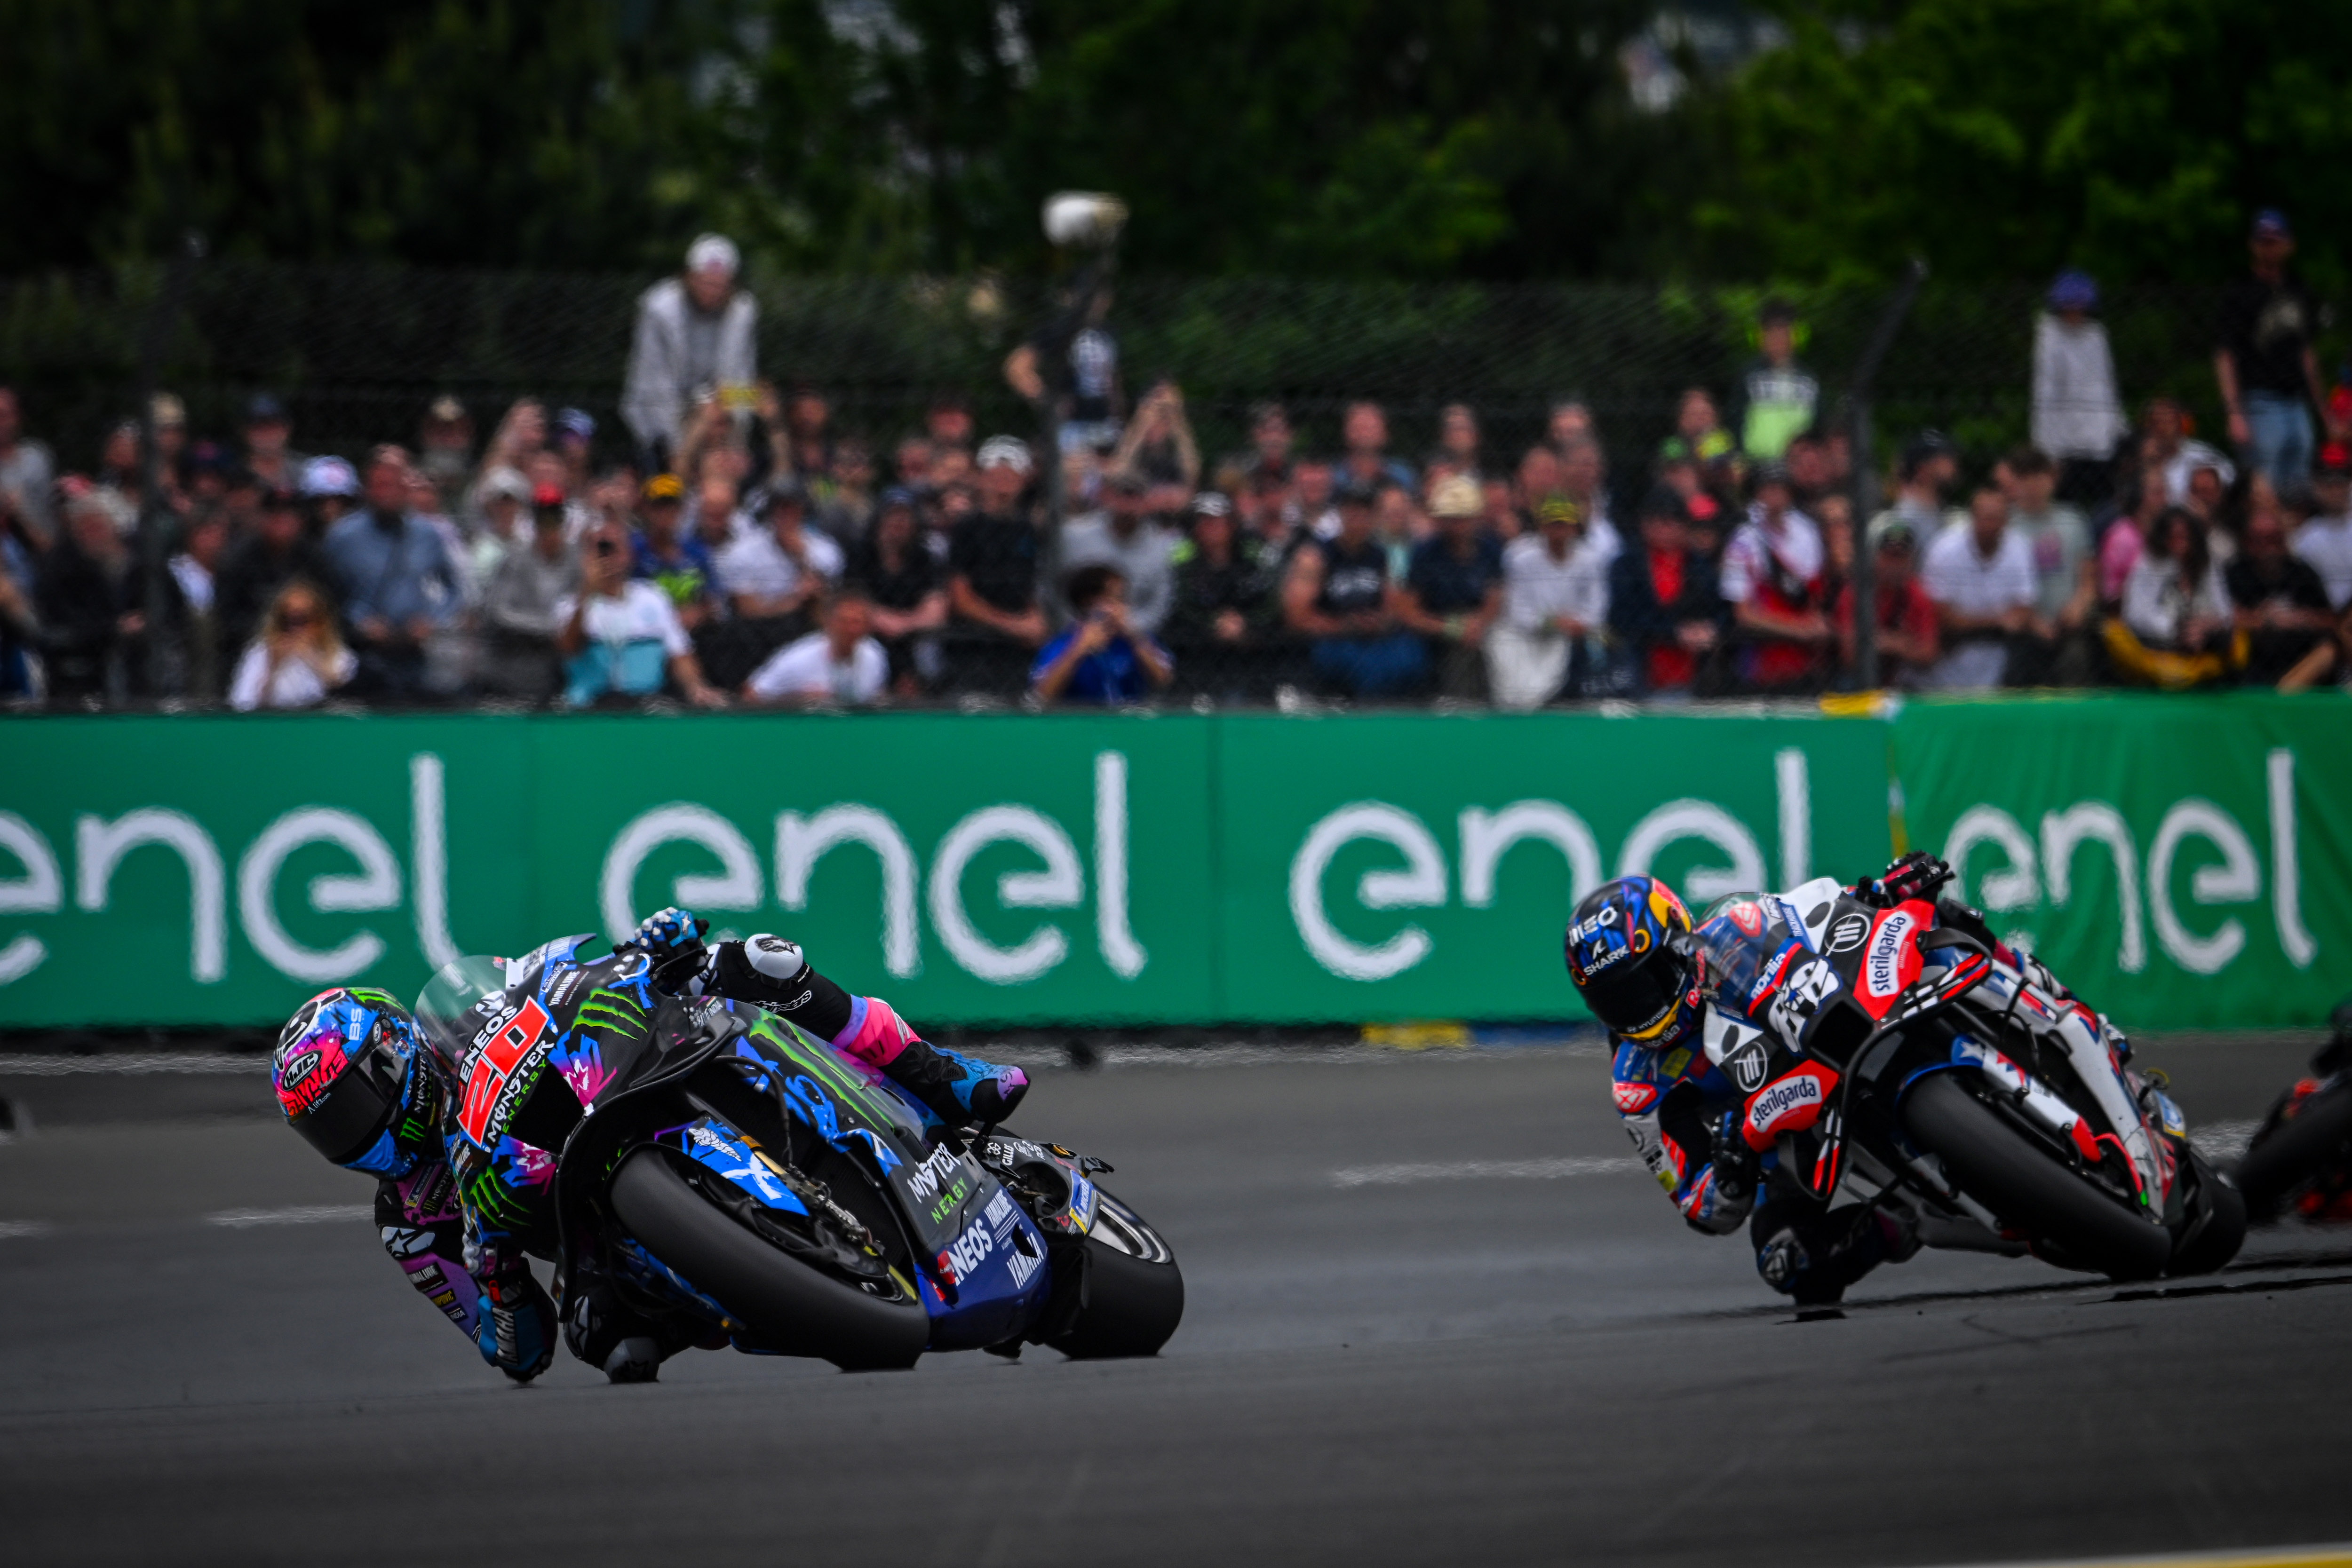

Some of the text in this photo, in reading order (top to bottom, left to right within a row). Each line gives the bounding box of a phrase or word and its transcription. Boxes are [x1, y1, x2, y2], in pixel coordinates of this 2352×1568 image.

[598, 751, 1148, 984] enel
[1288, 747, 1812, 982] enel
[1942, 748, 2318, 975] enel
[1583, 945, 1630, 976] SHARK
[1750, 951, 1786, 1000] aprilia
[1872, 917, 1907, 992] sterilgarda
[548, 971, 580, 1006] YAMALUBE
[349, 1008, 362, 1041] BS
[459, 1006, 517, 1083] ENEOS
[284, 1052, 316, 1088] HJC
[456, 994, 550, 1148] 20
[487, 1039, 555, 1143] MONSTER
[502, 1058, 547, 1133] ENERGY
[313, 1092, 331, 1109] lif3.com
[1753, 1079, 1816, 1125] sterilgarda
[907, 1141, 961, 1204] MNSTER
[931, 1176, 968, 1225] NERGY
[984, 1188, 1014, 1230] YAMALUBE
